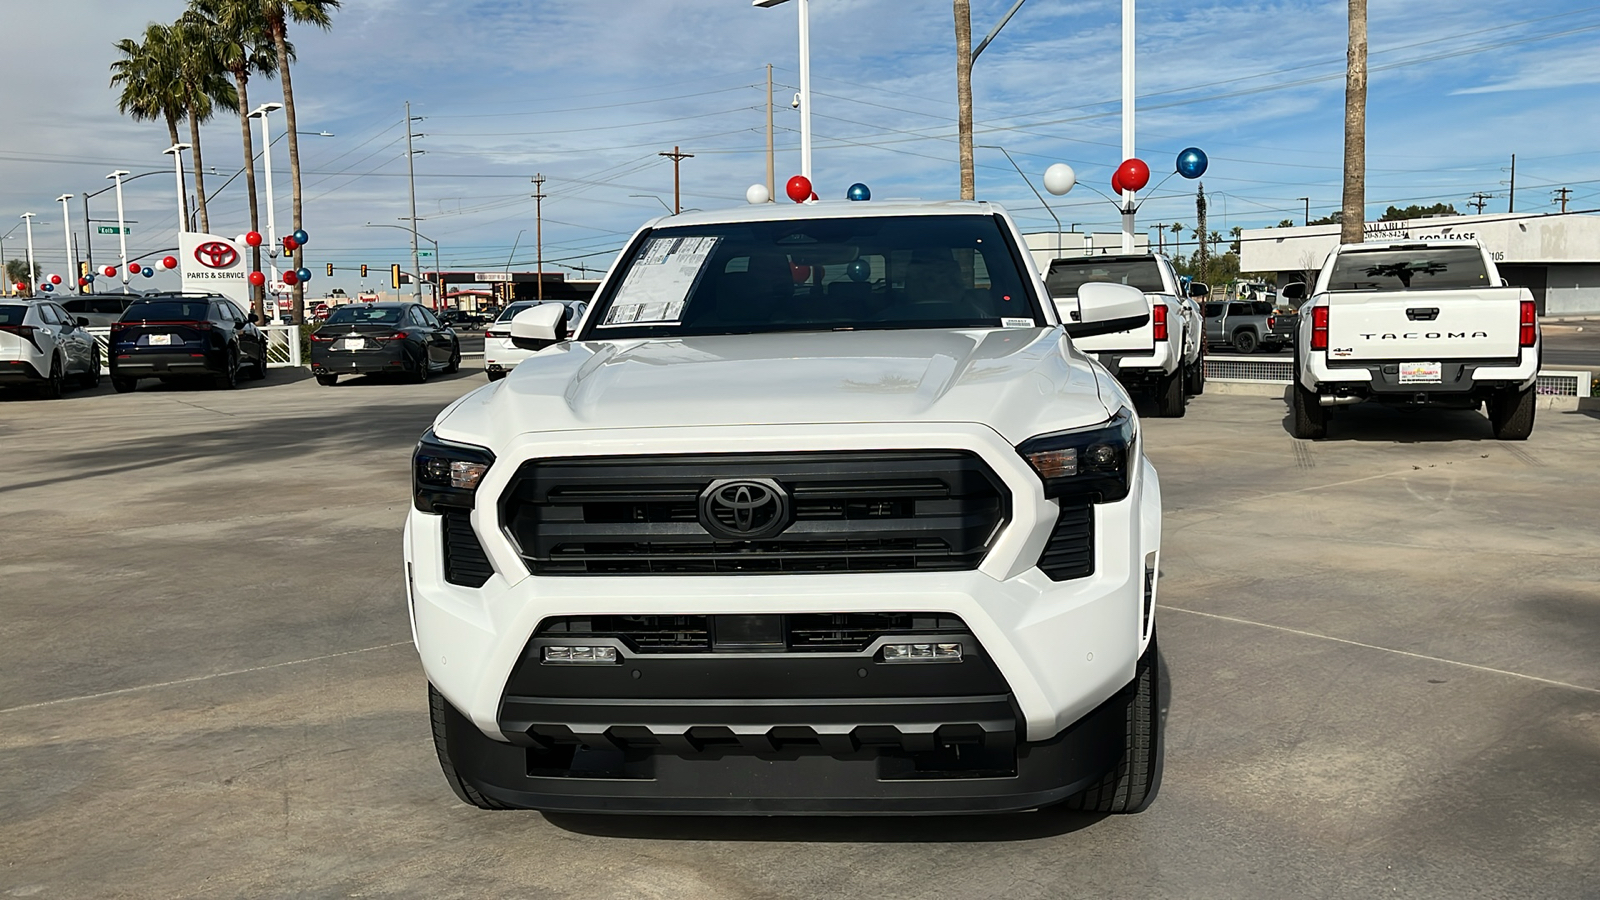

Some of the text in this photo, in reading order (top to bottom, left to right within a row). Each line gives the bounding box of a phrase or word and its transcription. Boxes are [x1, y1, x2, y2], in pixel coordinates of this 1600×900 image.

[1364, 221, 1407, 232] VAILABLE
[1364, 230, 1405, 239] 20-878-8424
[1489, 251, 1504, 261] 105
[1359, 331, 1488, 340] TACOMA
